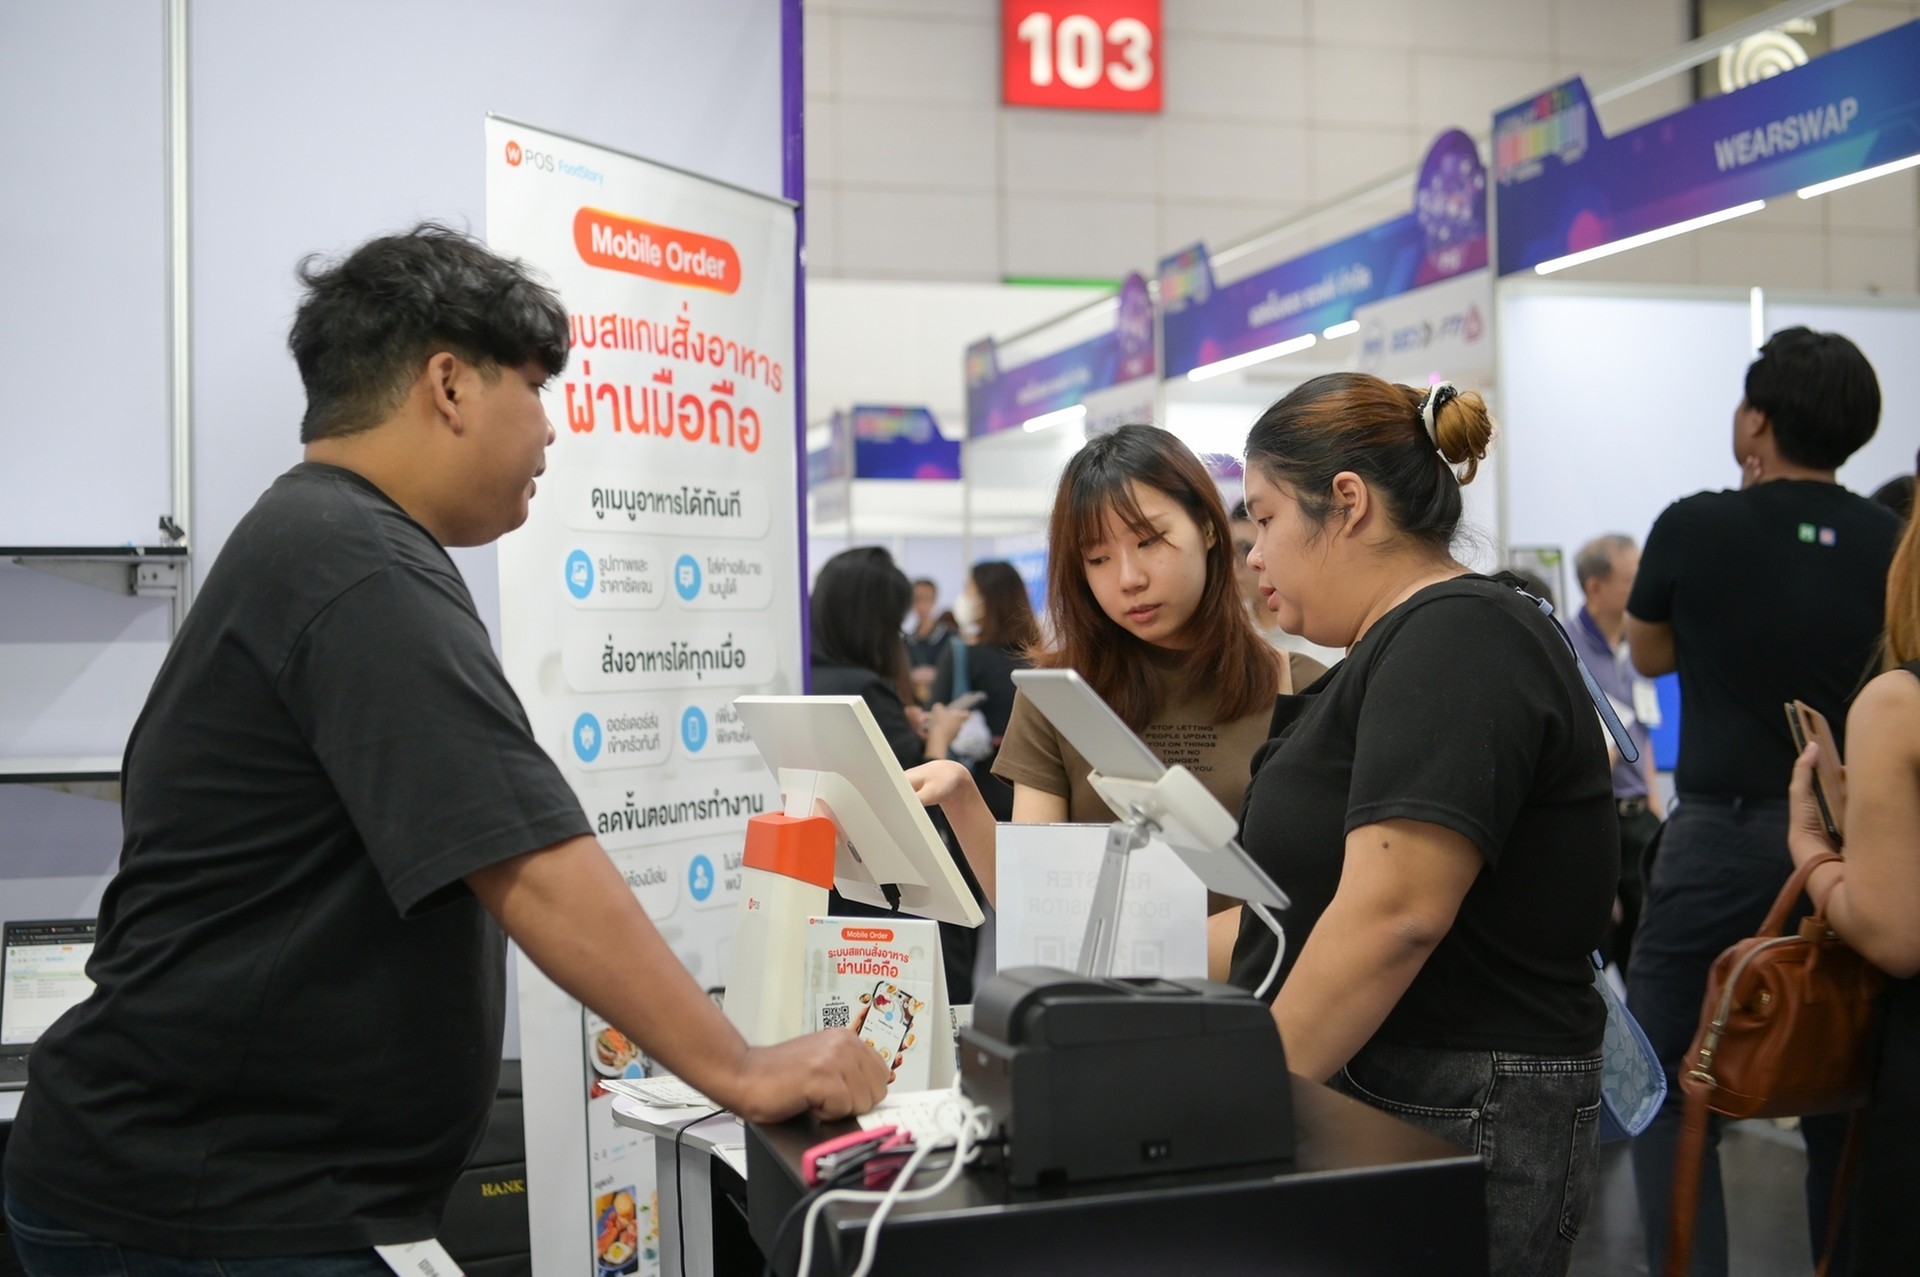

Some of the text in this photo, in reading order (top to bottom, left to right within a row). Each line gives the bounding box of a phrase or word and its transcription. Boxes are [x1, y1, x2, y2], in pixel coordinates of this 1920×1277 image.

[1017, 11, 1154, 92] 103
[1714, 97, 1859, 172] WEARSWAP
[525, 148, 554, 173] POS
[591, 223, 726, 281] Mobile Order
[569, 302, 783, 393] บสแกนสั่งอาหาร
[565, 360, 760, 454] ผ่านมือถือ
[591, 486, 742, 521] ดูเมนูอาหารได้ทันที
[601, 633, 746, 680] สั่งอาหารได้ทุกเมื่อ
[597, 789, 764, 834] ลดขั้นตอนการทำงาน
[828, 943, 909, 963] ระบบสแกนสั่งอาหาร
[846, 930, 888, 940] Mobile Order
[837, 958, 898, 978] ผ่านมือถือ
[481, 1179, 525, 1197] HANK
